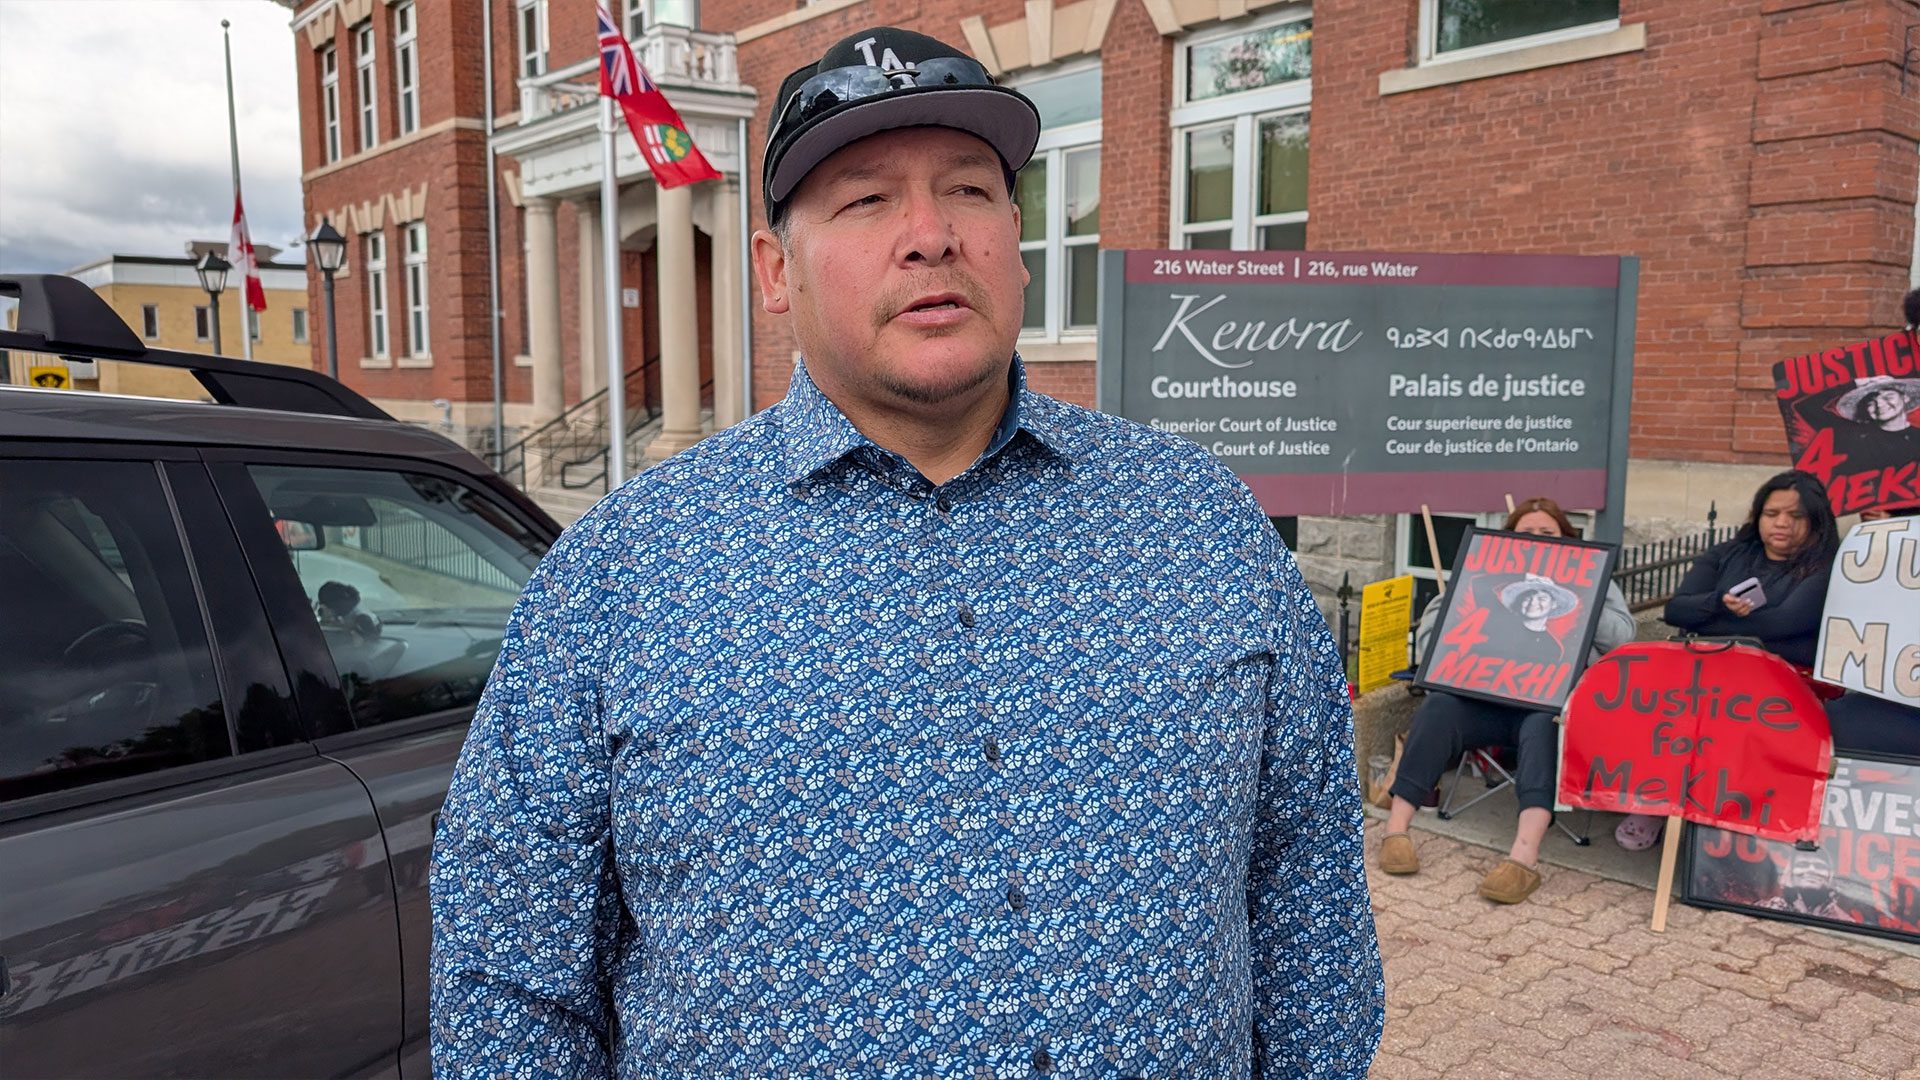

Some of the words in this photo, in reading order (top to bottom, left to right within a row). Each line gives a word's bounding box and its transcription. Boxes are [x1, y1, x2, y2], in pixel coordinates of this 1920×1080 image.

[1153, 259, 1182, 275] 216
[1186, 259, 1235, 275] Water
[1237, 259, 1285, 276] Street
[1308, 260, 1340, 278] 216,
[1342, 264, 1368, 277] rue
[1370, 262, 1418, 278] Water
[1151, 293, 1364, 369] Kenora
[1151, 375, 1297, 399] Courthouse
[1389, 373, 1463, 397] Palais
[1468, 373, 1499, 397] de
[1502, 373, 1586, 401] justice
[1150, 417, 1216, 434] Superior
[1219, 417, 1262, 432] Court
[1265, 416, 1282, 432] of
[1285, 416, 1338, 432] Justice
[1386, 416, 1422, 431] Cour
[1504, 414, 1523, 430] de
[1524, 414, 1573, 432] justice
[1212, 441, 1255, 457] Court
[1258, 440, 1275, 456] of
[1277, 440, 1331, 456] Justice
[1386, 439, 1421, 454] Cour
[1424, 438, 1442, 454] de
[1443, 438, 1493, 456] justice
[1495, 438, 1513, 453] de
[1794, 427, 1848, 487] 4
[1465, 534, 1601, 587] JUSTICE
[1443, 608, 1490, 656] 4
[1428, 652, 1571, 699] MEKHI
[1593, 655, 1800, 730] Justice
